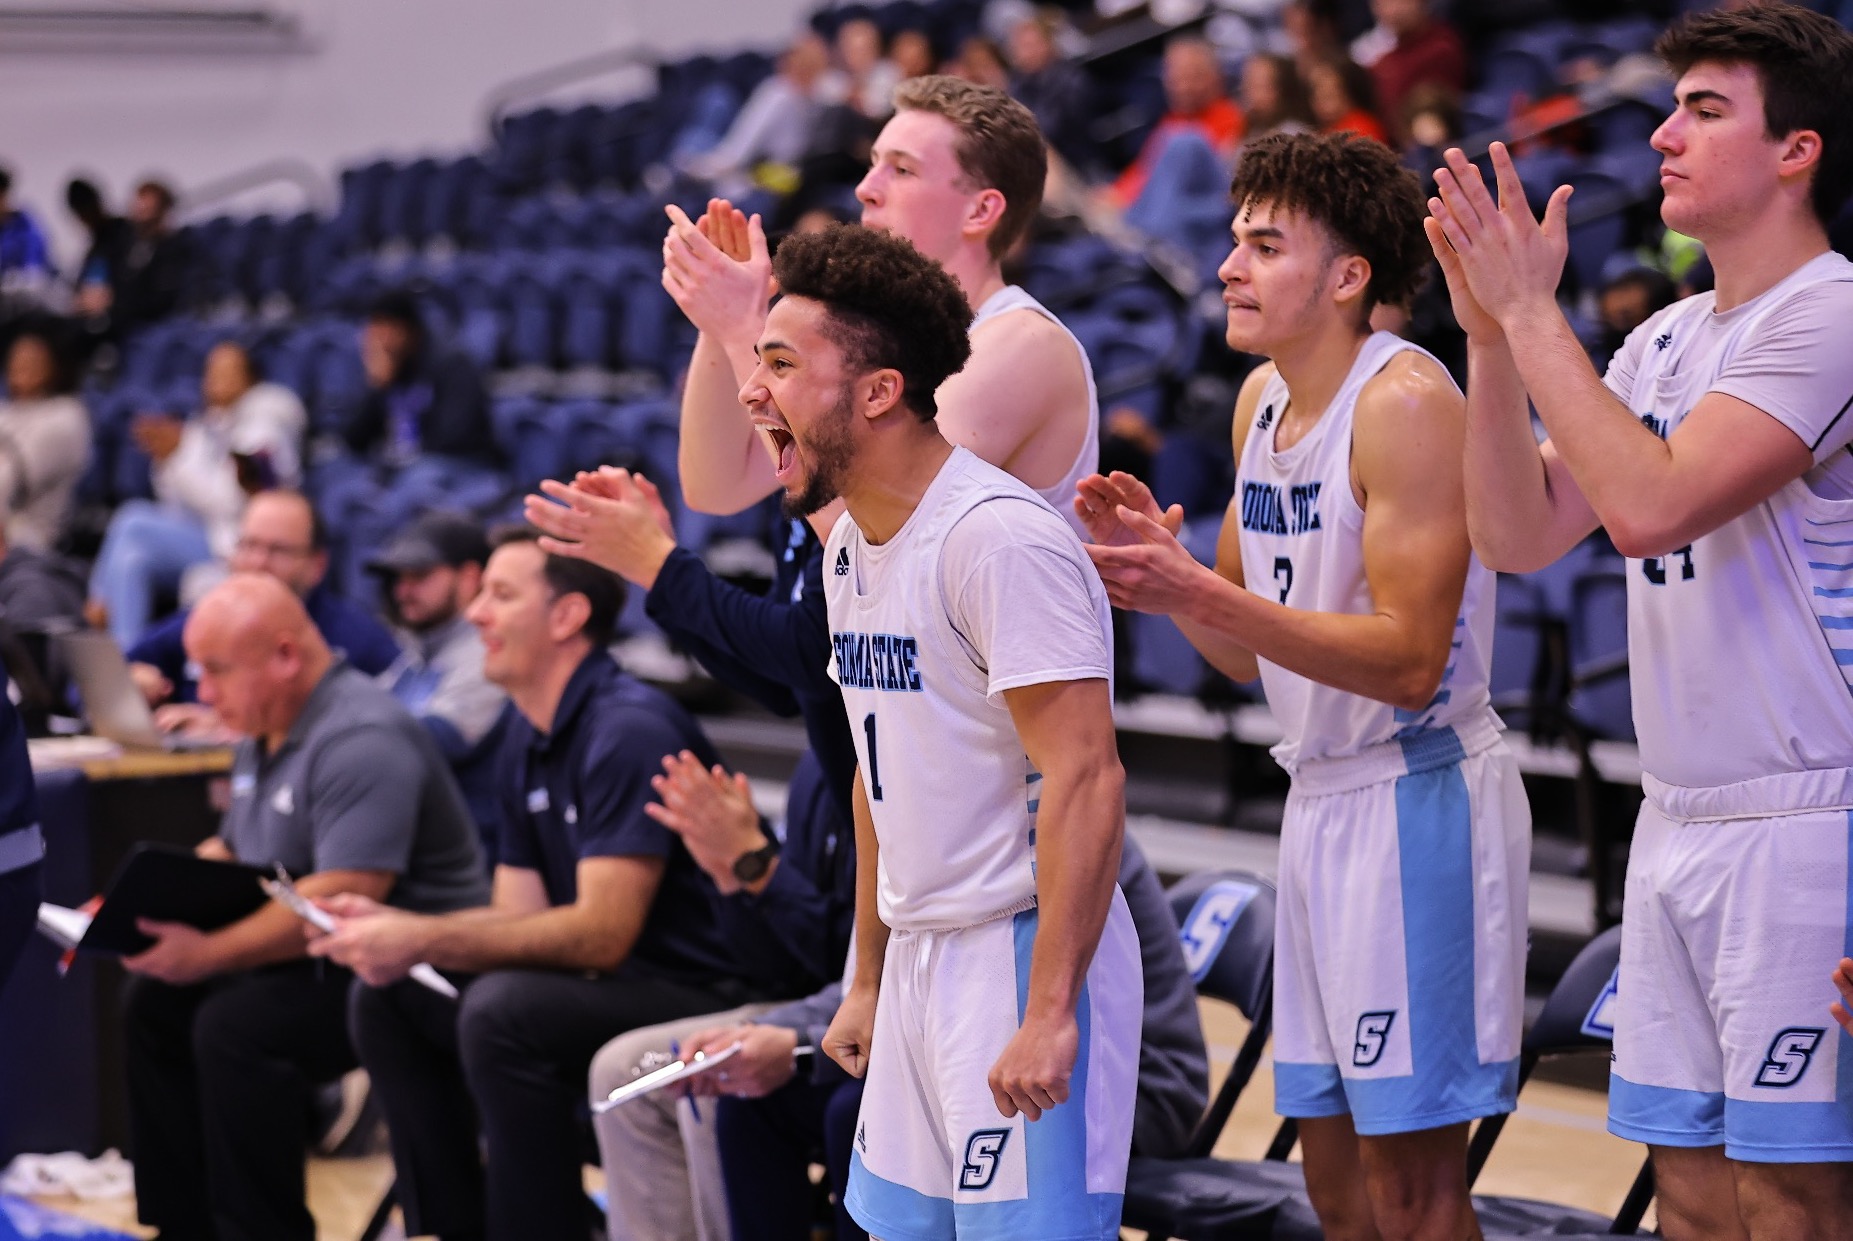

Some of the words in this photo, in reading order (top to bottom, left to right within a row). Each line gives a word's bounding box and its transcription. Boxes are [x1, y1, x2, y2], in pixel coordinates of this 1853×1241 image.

[863, 712, 883, 802] 1
[1353, 1008, 1399, 1067] S
[1753, 1026, 1828, 1089] S
[958, 1127, 1013, 1192] S
